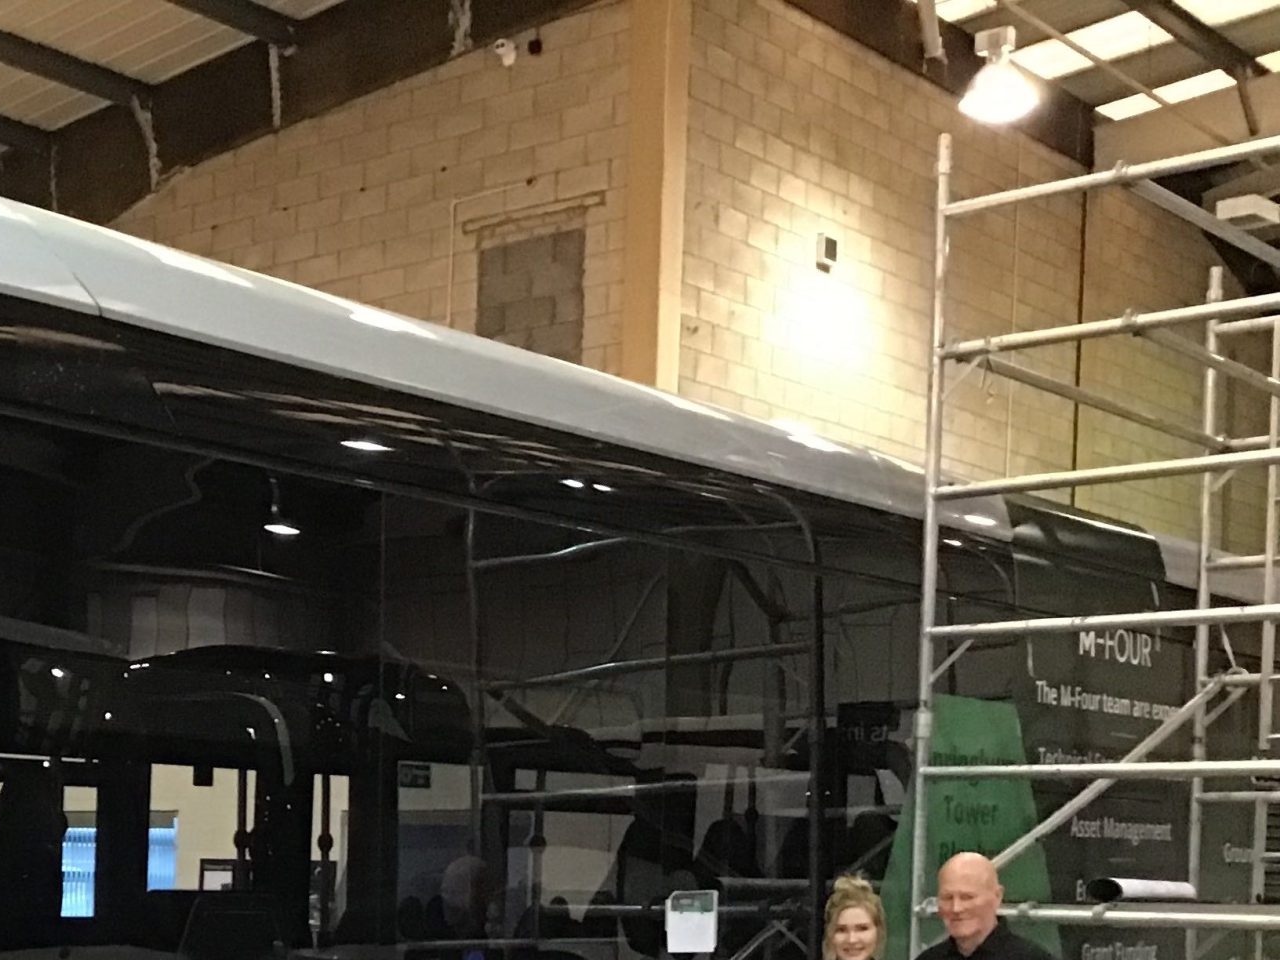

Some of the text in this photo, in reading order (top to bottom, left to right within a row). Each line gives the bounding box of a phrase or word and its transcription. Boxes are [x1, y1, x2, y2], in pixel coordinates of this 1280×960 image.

[1036, 680, 1058, 705] The
[1060, 684, 1101, 710] M-Four
[1103, 693, 1131, 715] team
[1132, 700, 1150, 719] are
[944, 795, 998, 825] Tower
[1071, 816, 1171, 846] Asset Management
